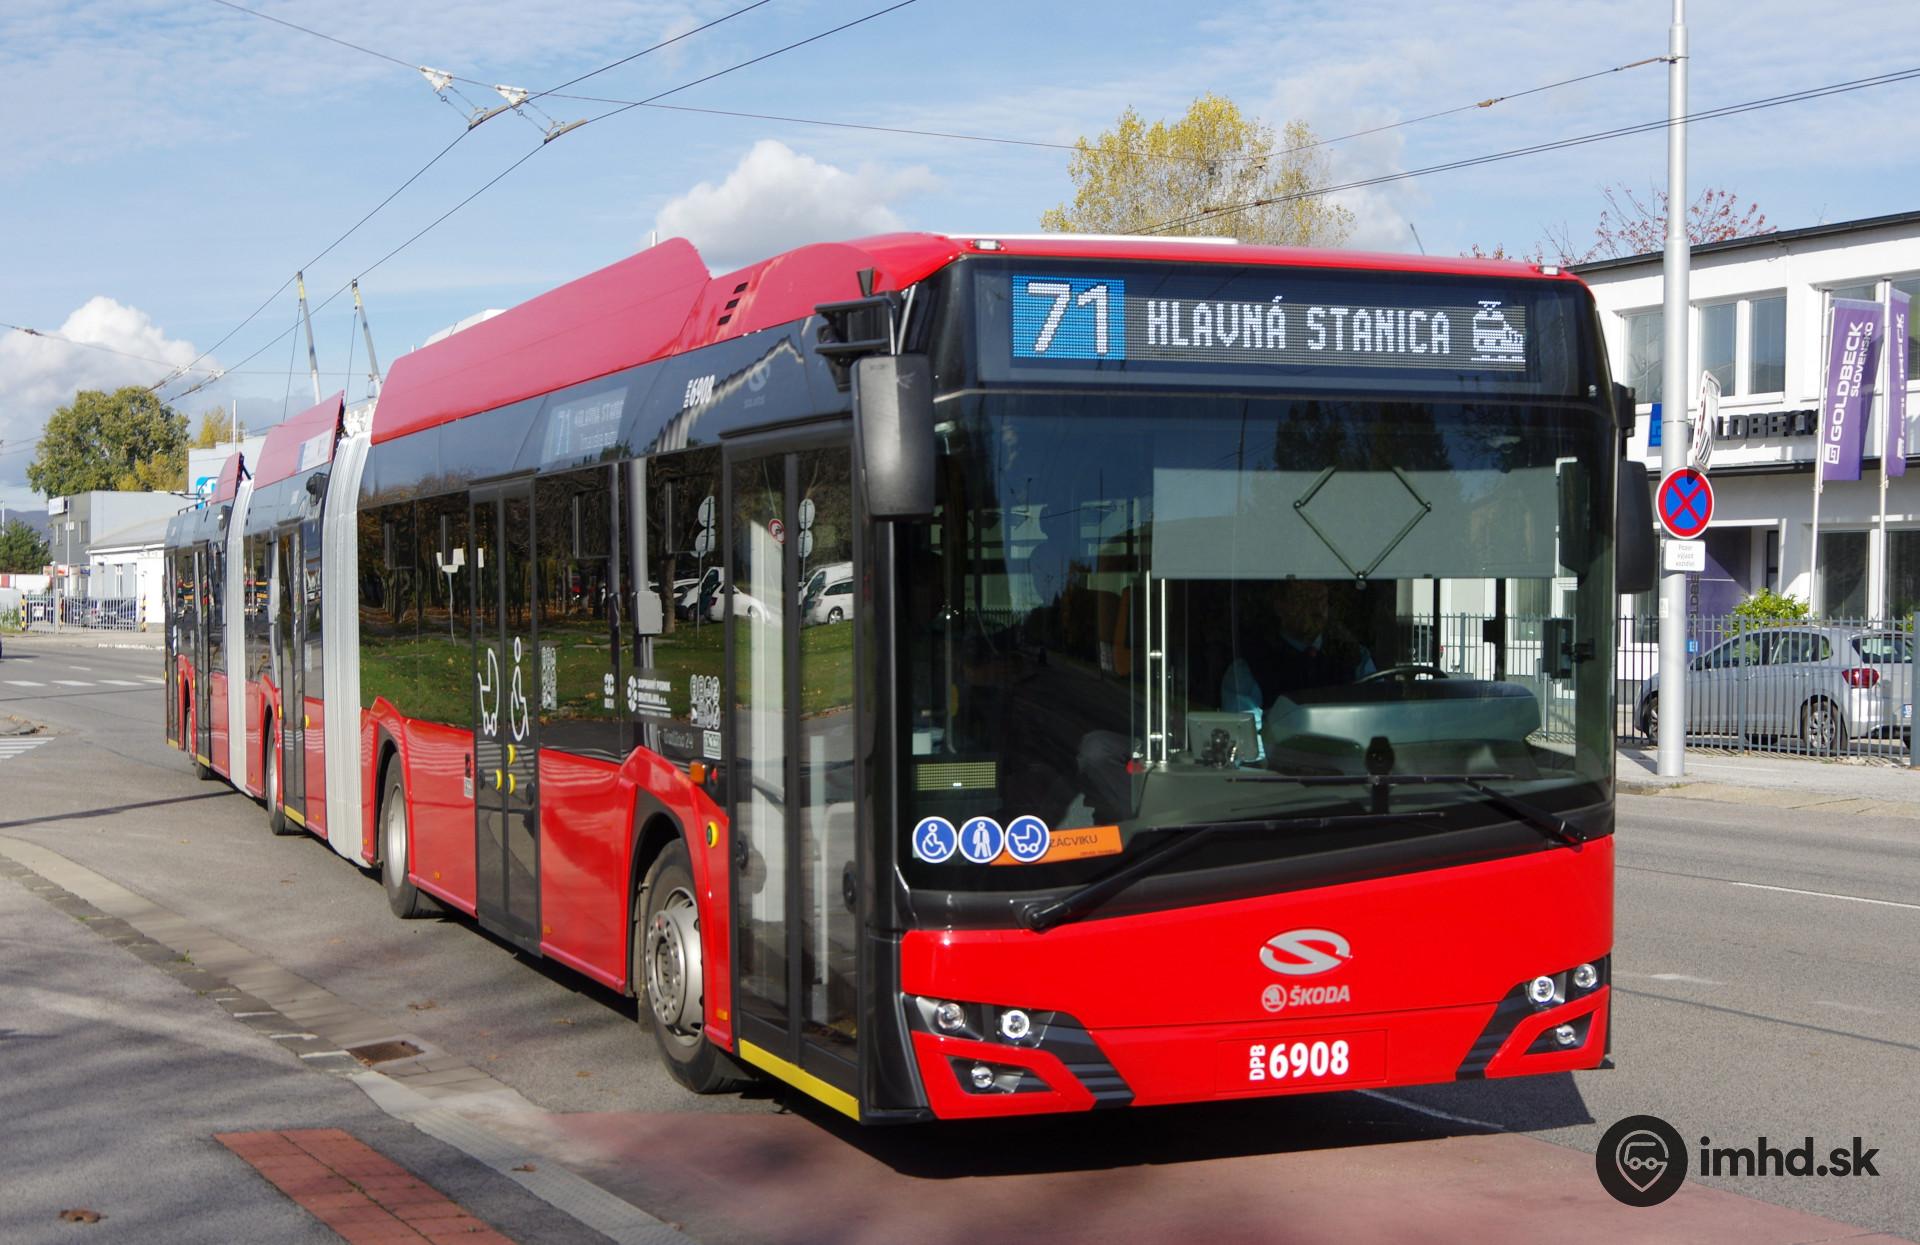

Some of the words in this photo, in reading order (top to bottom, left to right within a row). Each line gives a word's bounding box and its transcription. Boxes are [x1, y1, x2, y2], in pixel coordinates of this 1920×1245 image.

[1027, 281, 1109, 355] 71
[1147, 296, 1287, 349] HLAVNÁ
[1306, 307, 1450, 355] STANICA
[1831, 321, 1864, 442] GOLDBECK
[1851, 322, 1874, 397] SLOVENSKO
[1288, 985, 1351, 1006] ŠKODA
[1249, 1044, 1266, 1081] DPB
[1269, 1040, 1349, 1079] 6908
